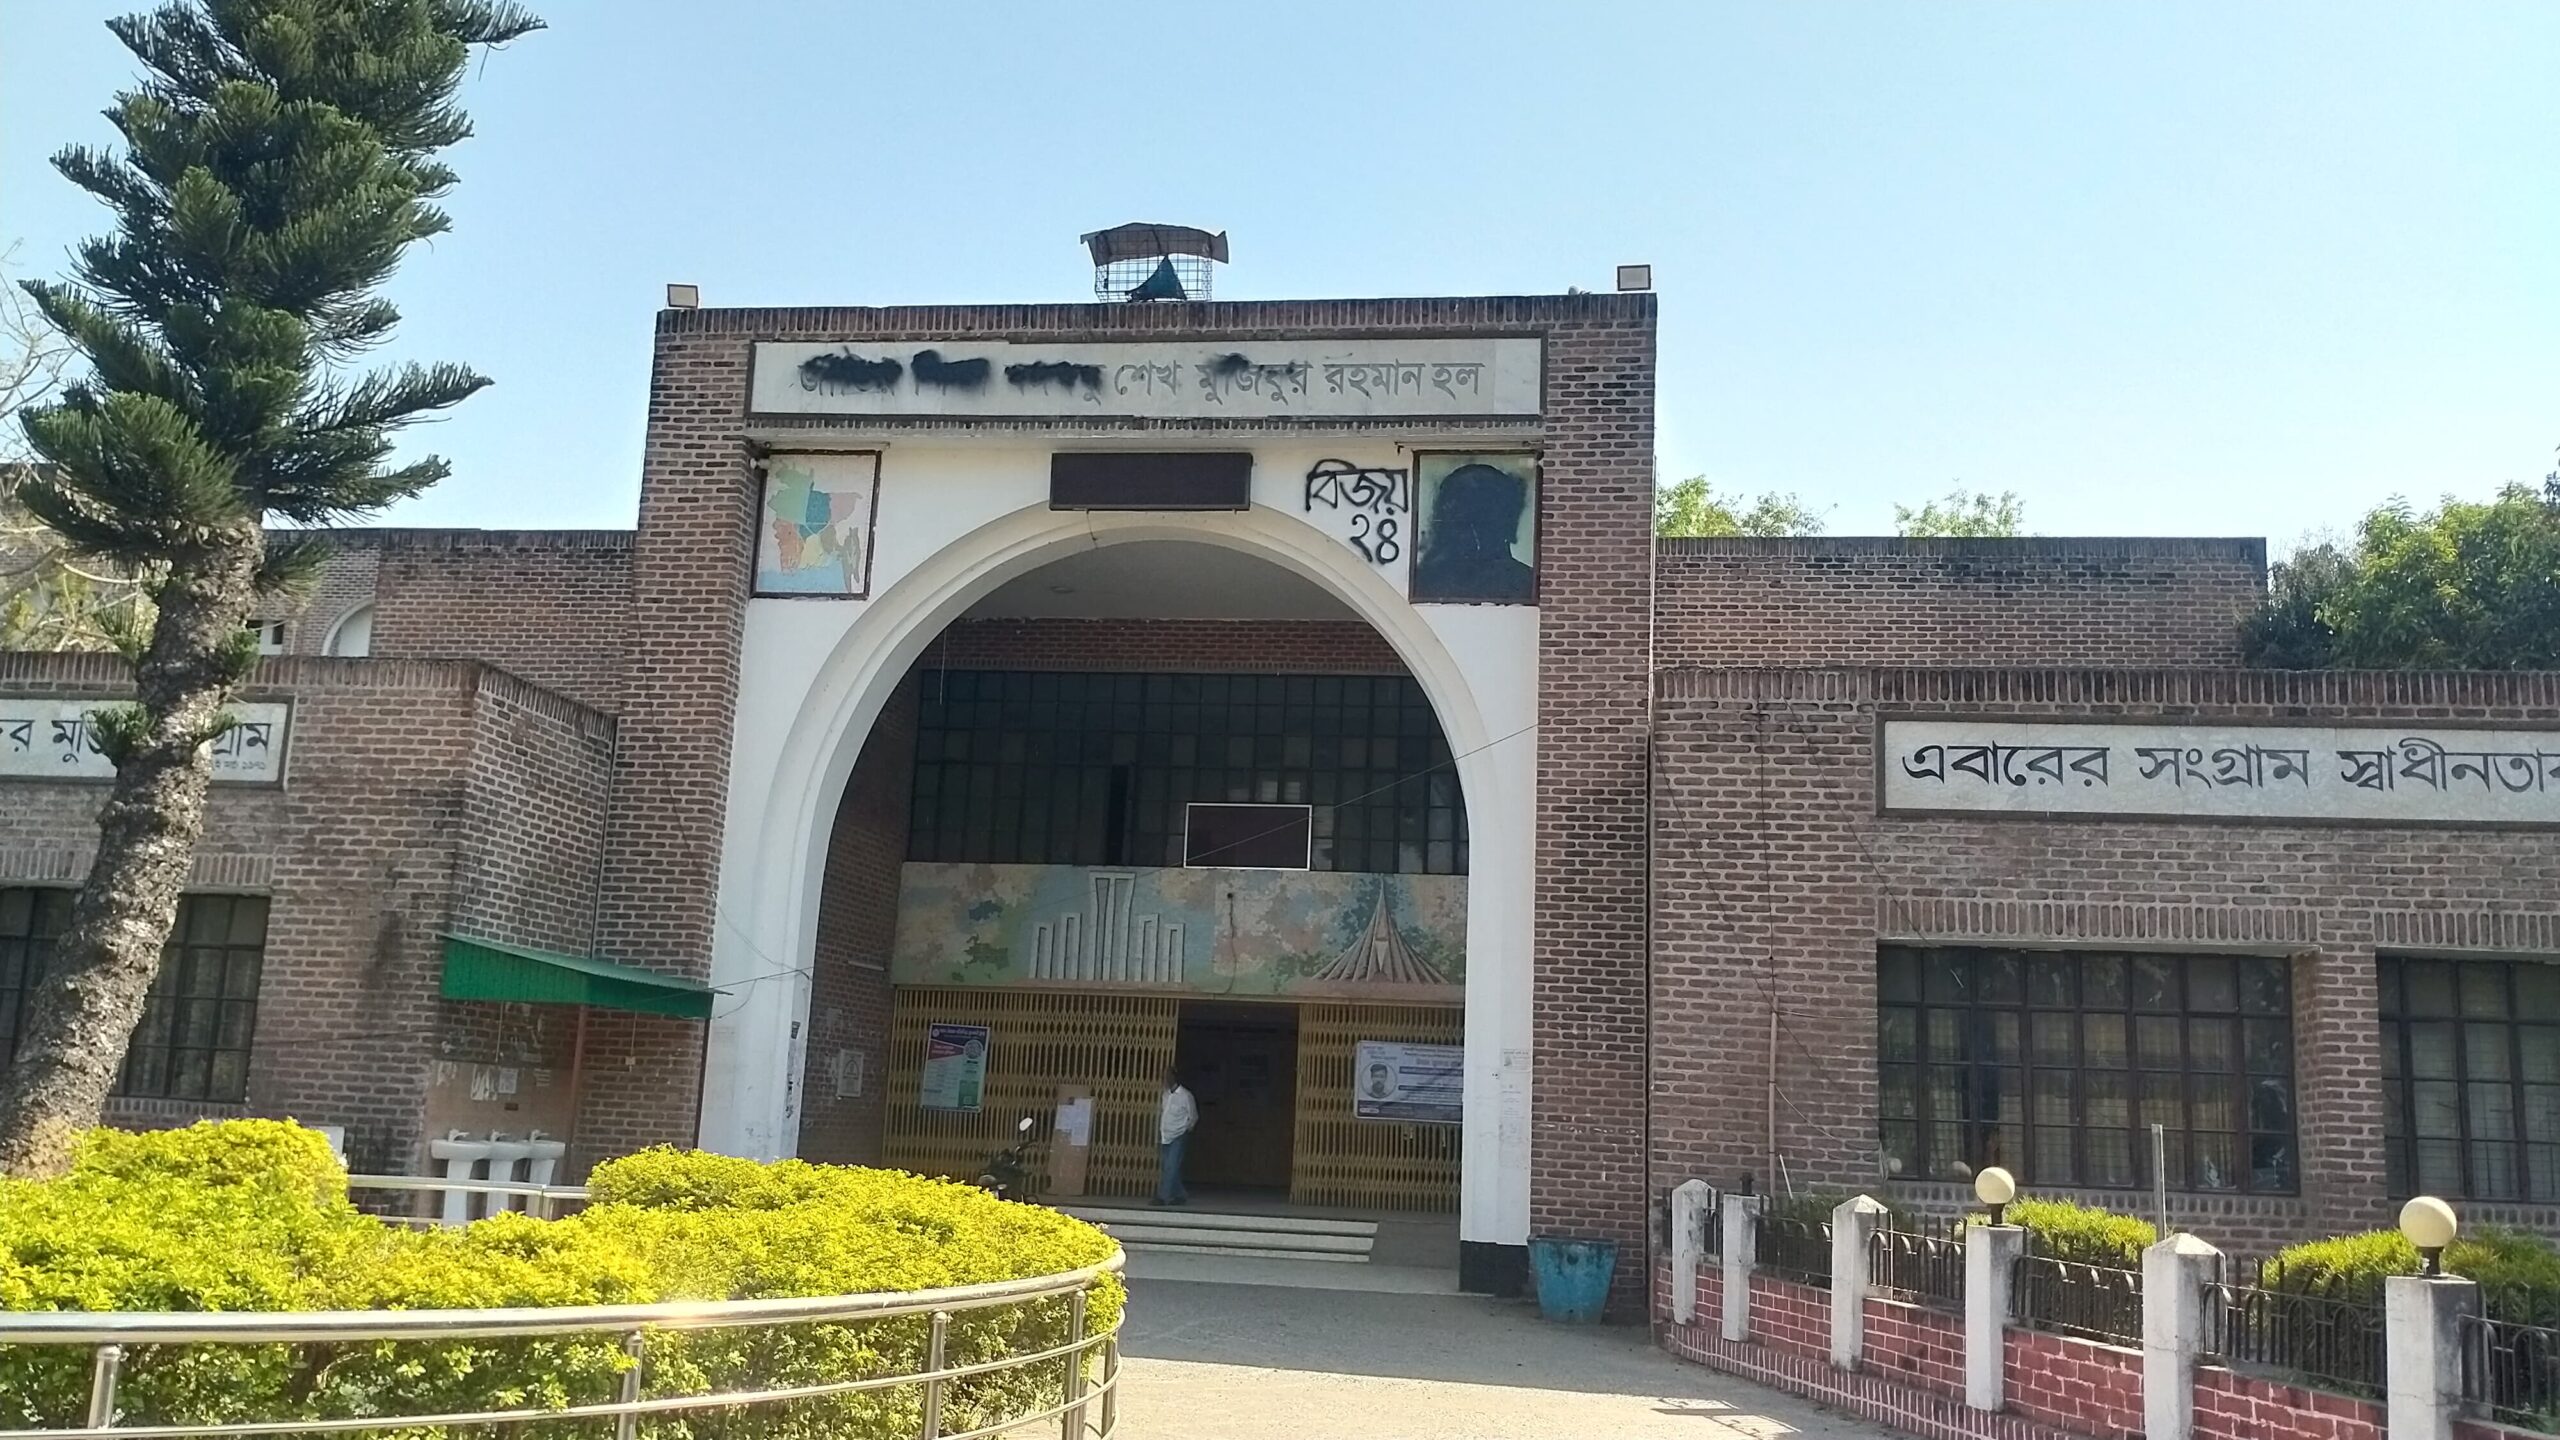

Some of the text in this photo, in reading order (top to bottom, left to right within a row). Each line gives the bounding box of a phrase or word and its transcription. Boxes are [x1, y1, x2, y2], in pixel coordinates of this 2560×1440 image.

[1114, 358, 1182, 397] শেখ
[1323, 354, 1425, 400] রহমান
[1432, 362, 1485, 400] হল
[1304, 458, 1410, 515] বিজয়
[1350, 513, 1400, 565] ২৪
[1902, 740, 2110, 788] এবারের
[2135, 742, 2310, 789] সংগ্রাম
